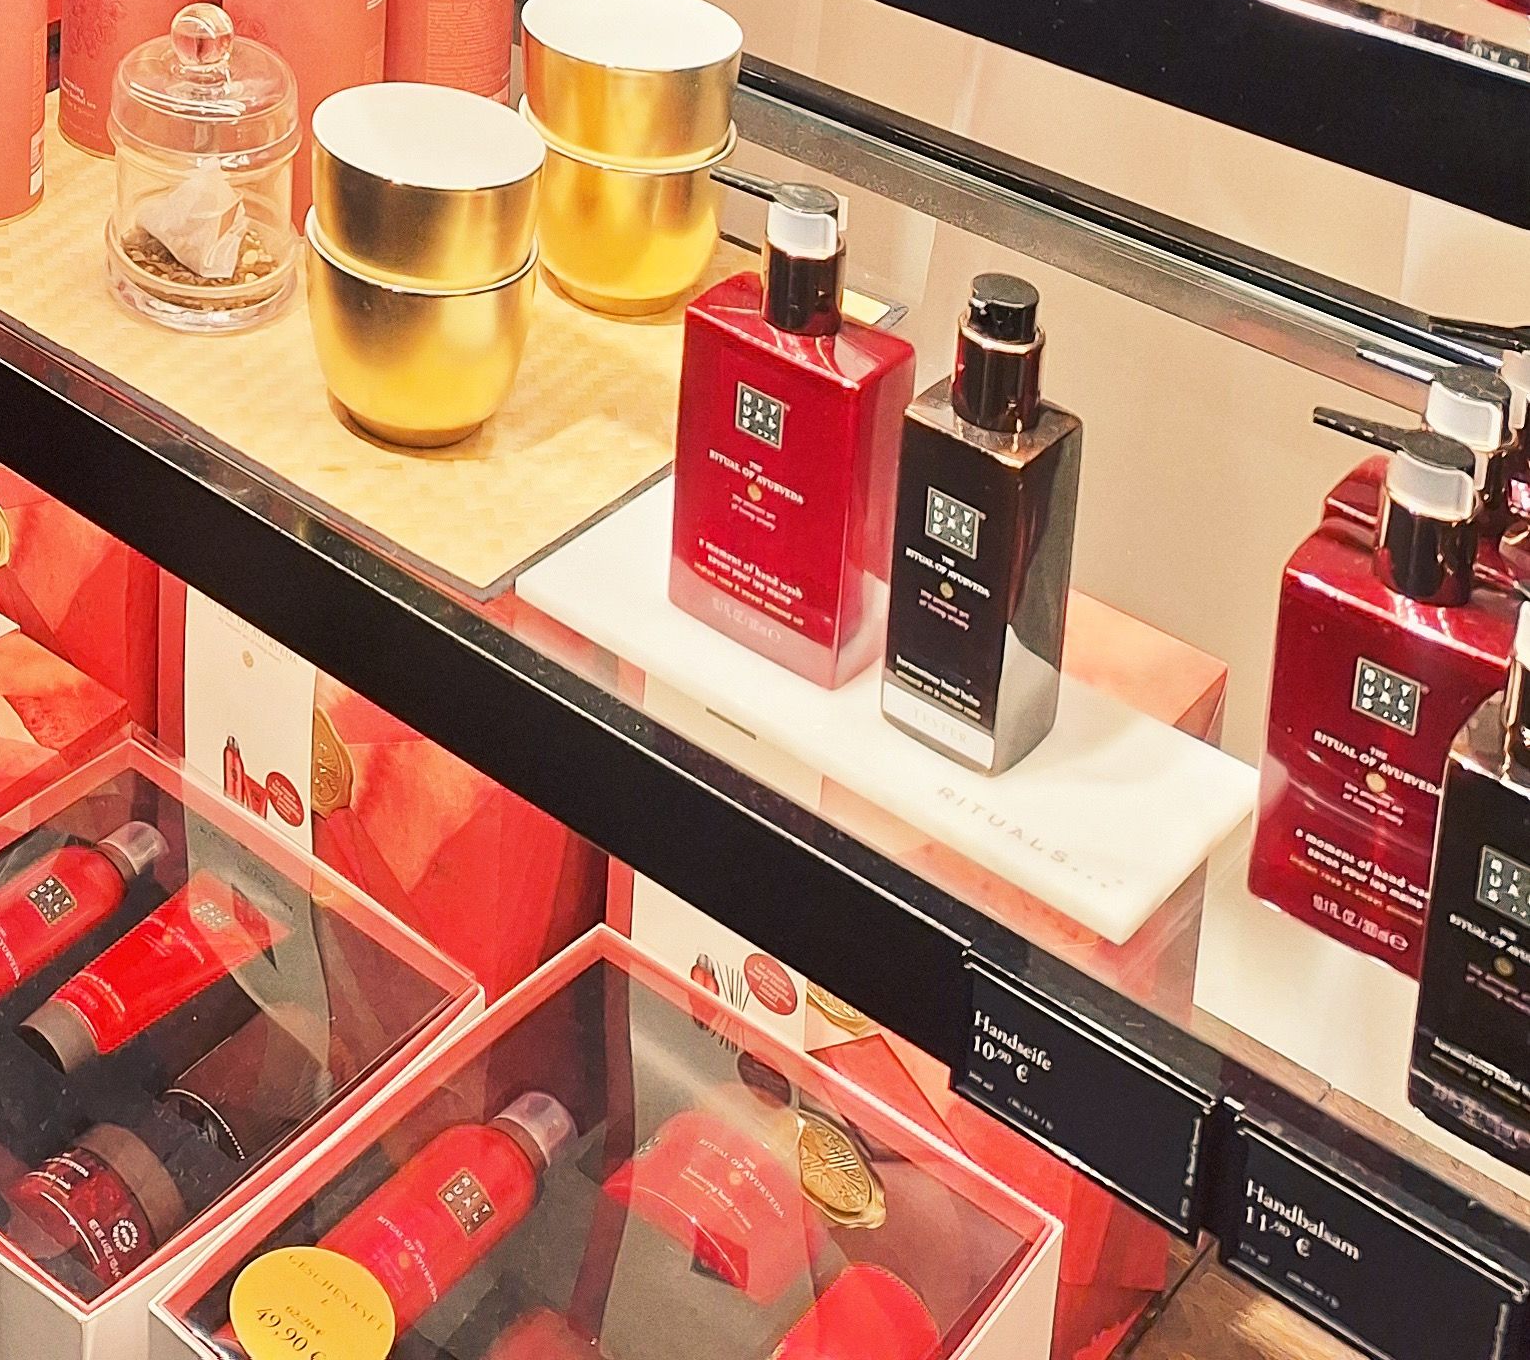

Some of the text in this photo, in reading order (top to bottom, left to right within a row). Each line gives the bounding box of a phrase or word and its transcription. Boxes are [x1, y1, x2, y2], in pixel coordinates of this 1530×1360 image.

[709, 448, 805, 506] RITUAL AYURVEDA
[905, 546, 991, 599] RITUAL AYURVEDA
[1314, 729, 1444, 797] RITUAL OF AYURVEDA
[1356, 859, 1374, 873] of
[1373, 863, 1407, 890] hand
[973, 1009, 1052, 1072] Handseife
[1015, 1063, 1030, 1084] €
[730, 1157, 745, 1170] OF
[742, 1169, 785, 1219] AYURVEDA
[1245, 1177, 1360, 1262] Handbalsam
[1295, 1237, 1312, 1258] €
[288, 1254, 390, 1332] GESCHENKSET
[403, 1238, 416, 1252] OF
[413, 1253, 439, 1304] AYURVEDA
